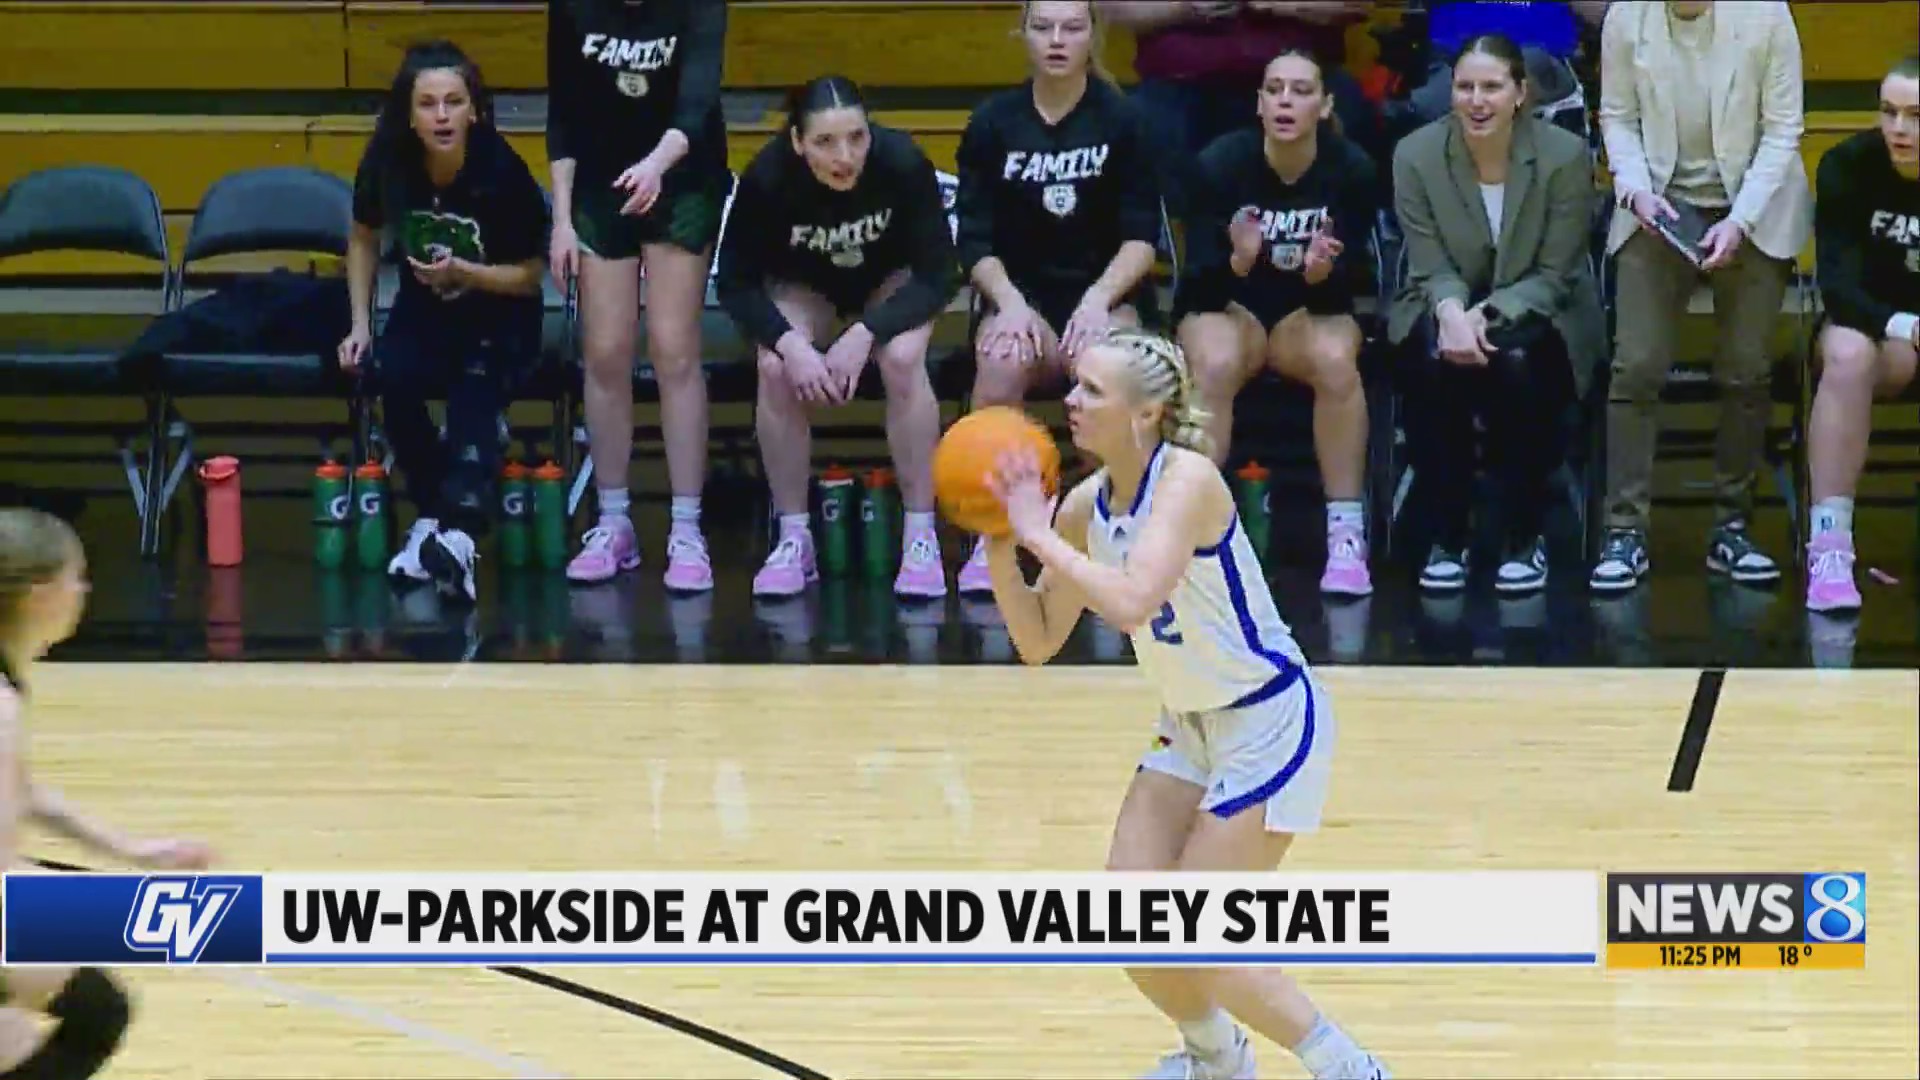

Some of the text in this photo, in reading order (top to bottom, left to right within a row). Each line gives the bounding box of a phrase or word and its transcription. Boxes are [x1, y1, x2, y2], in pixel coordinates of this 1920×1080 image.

[581, 33, 678, 70] FAMILY
[1003, 143, 1109, 182] FAMILY
[789, 207, 892, 253] FAMILY
[360, 492, 380, 514] G
[503, 492, 523, 515] G
[822, 499, 840, 521] G
